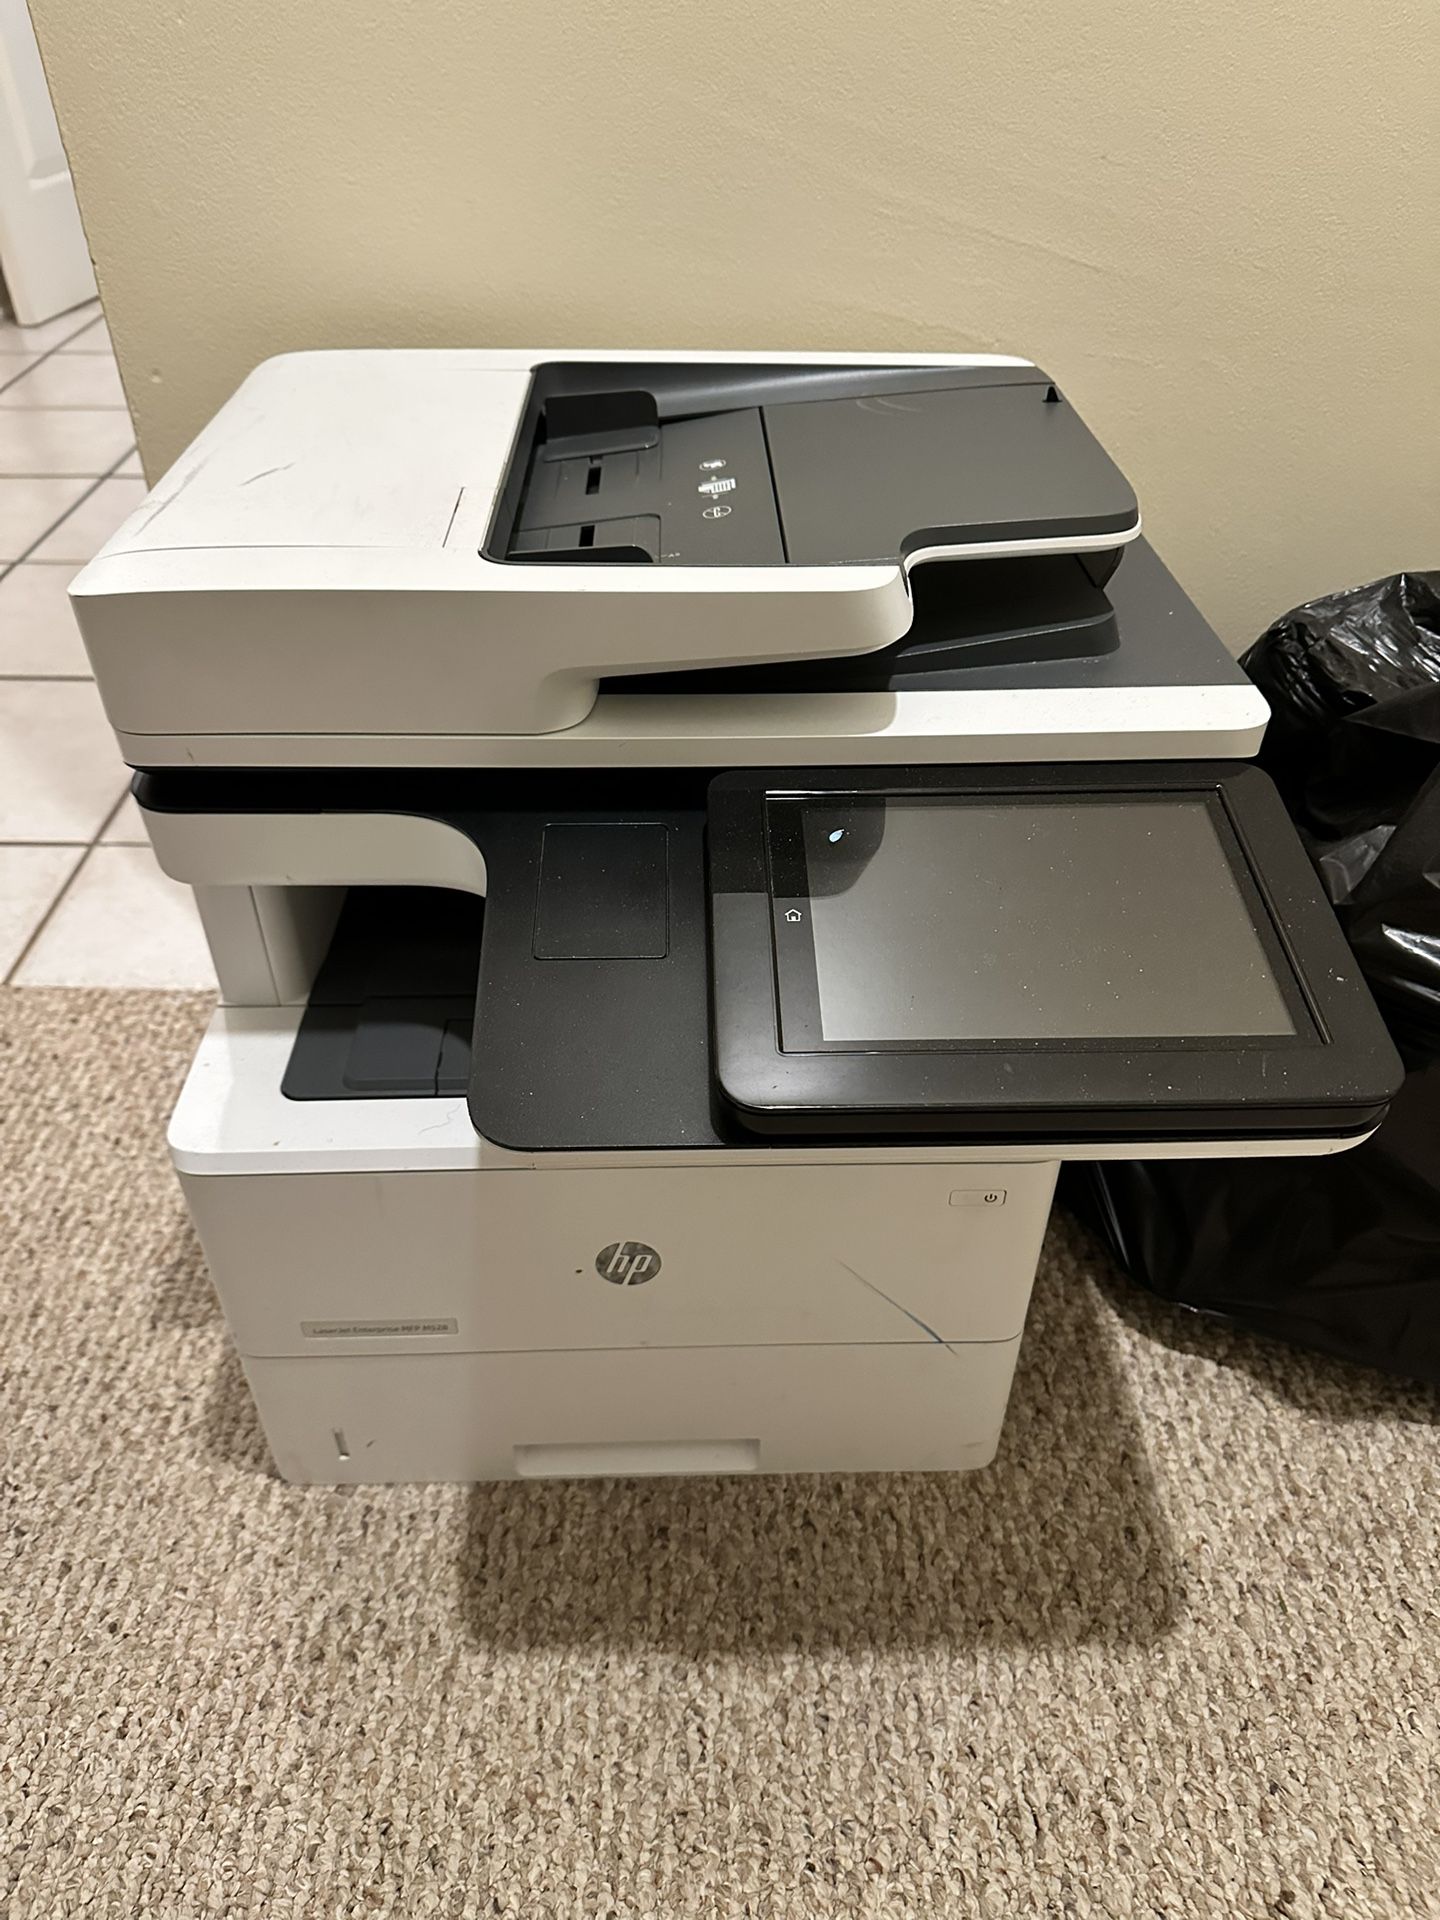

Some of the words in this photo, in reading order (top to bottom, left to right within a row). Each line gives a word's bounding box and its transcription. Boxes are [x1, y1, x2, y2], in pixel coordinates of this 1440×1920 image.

[605, 1241, 653, 1285] hp
[353, 1326, 399, 1334] Enterprise
[401, 1324, 421, 1332] MFP
